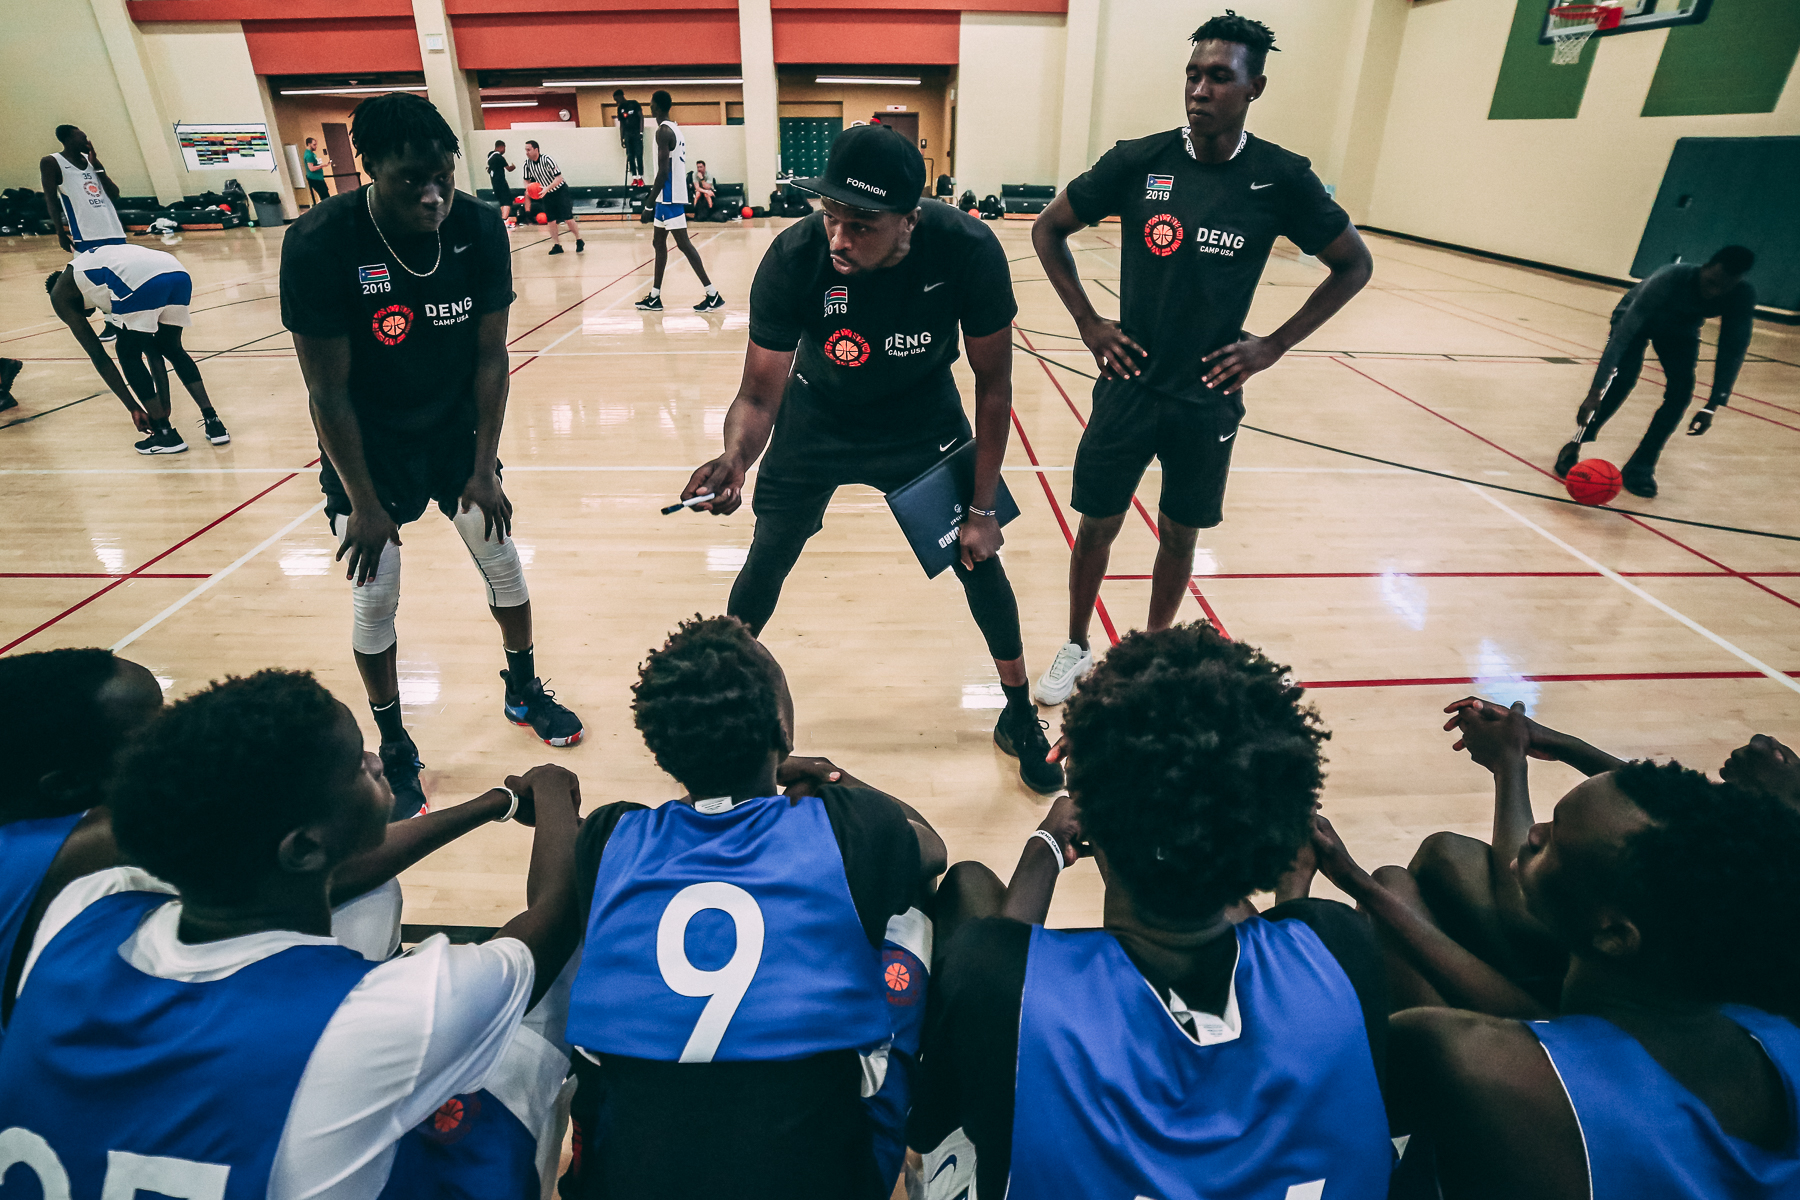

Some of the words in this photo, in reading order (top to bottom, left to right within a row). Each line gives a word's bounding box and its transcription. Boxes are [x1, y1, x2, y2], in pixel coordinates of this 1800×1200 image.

[846, 177, 887, 197] FORAIGN
[1145, 190, 1170, 200] 2019
[1196, 227, 1245, 249] DENG
[1199, 245, 1220, 254] CAMP
[1220, 248, 1234, 257] USA
[362, 281, 391, 294] 2019
[424, 297, 472, 317] DENG
[457, 314, 469, 323] USA
[885, 332, 932, 351] DENG
[888, 349, 909, 358] CAMP
[910, 346, 926, 355] USA
[938, 526, 960, 549] OARD
[656, 881, 765, 1064] 9
